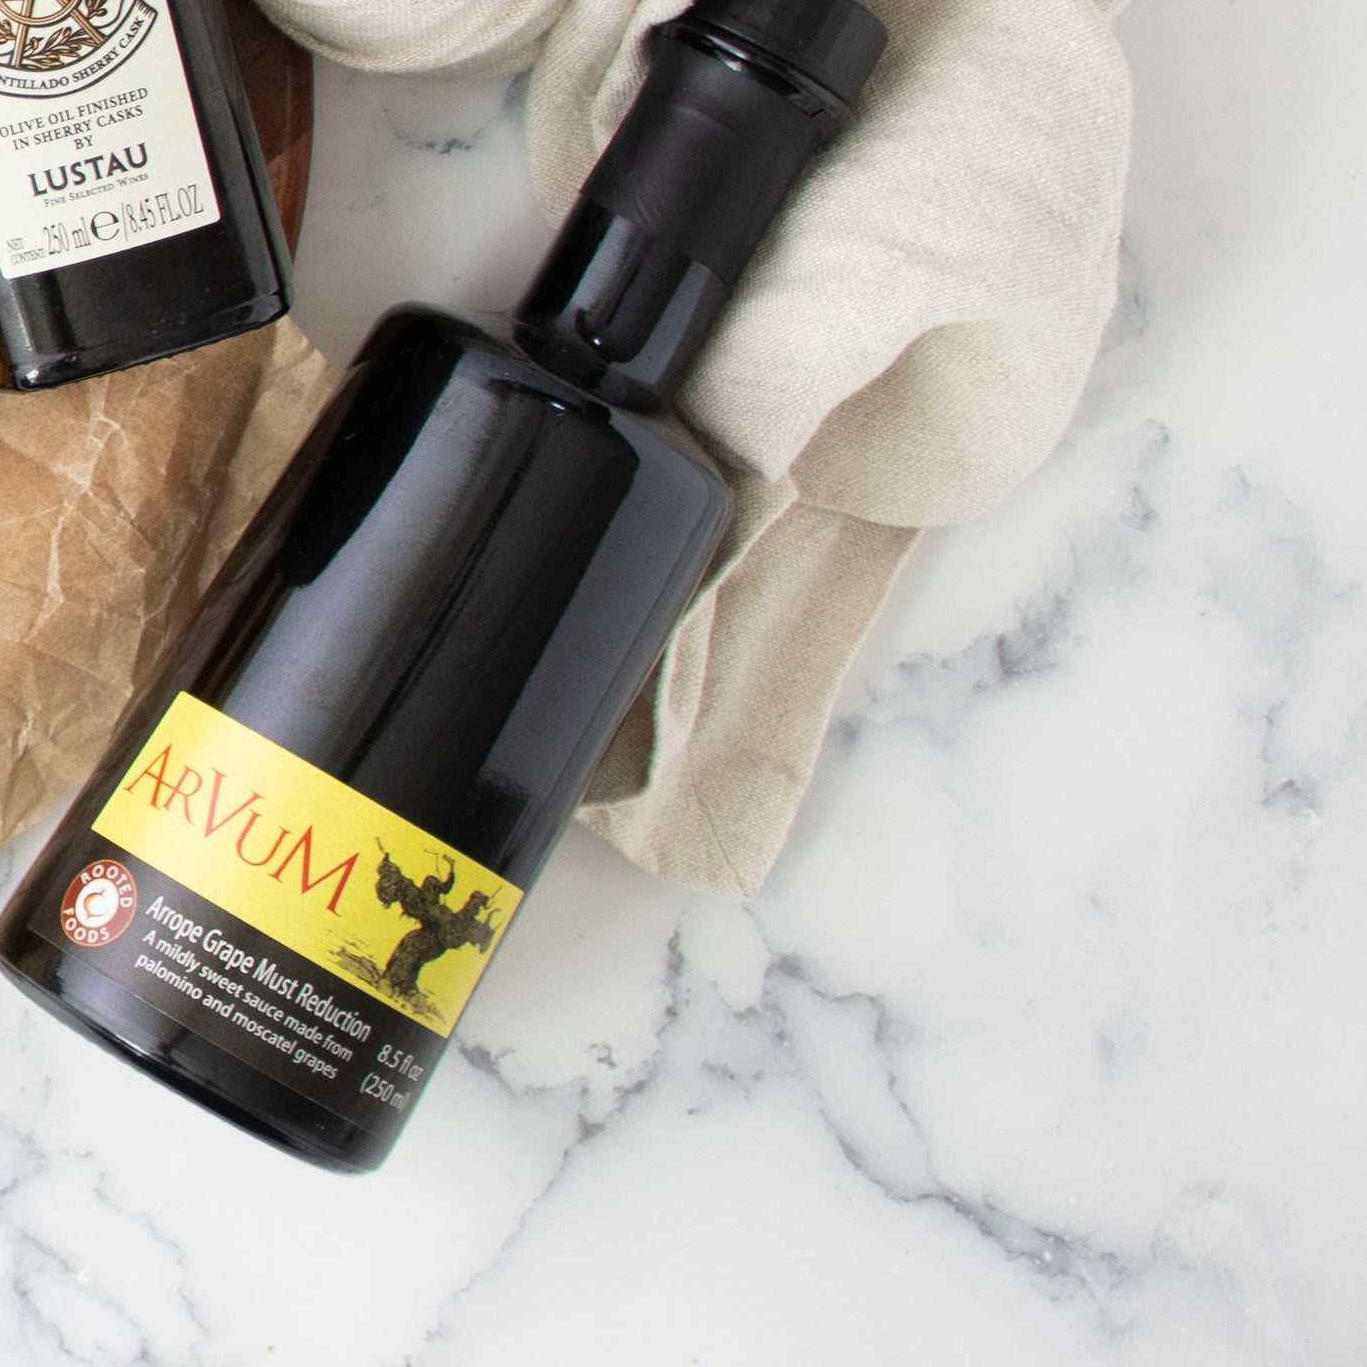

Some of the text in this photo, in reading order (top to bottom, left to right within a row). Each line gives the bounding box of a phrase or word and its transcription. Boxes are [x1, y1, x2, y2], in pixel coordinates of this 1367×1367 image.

[72, 49, 120, 83] SHERRY
[118, 17, 146, 49] CASK
[13, 104, 144, 150] IN SHERRY CASKS
[48, 109, 75, 126] OIL
[77, 87, 148, 118] FINISHED
[74, 135, 94, 150] BY
[27, 142, 148, 197] LUSTAU
[43, 222, 70, 255] 250
[72, 216, 92, 249] ml
[80, 865, 133, 908] ROOTED
[63, 908, 109, 943] FOODS
[146, 896, 372, 1042] Arrope Grape Must Reduction
[134, 954, 339, 1079] palomino and moscatel grapes
[142, 930, 353, 1062] A mildly sweet sauce made from
[377, 1044, 424, 1082] 8.5 fl oz
[360, 1072, 394, 1103] (250
